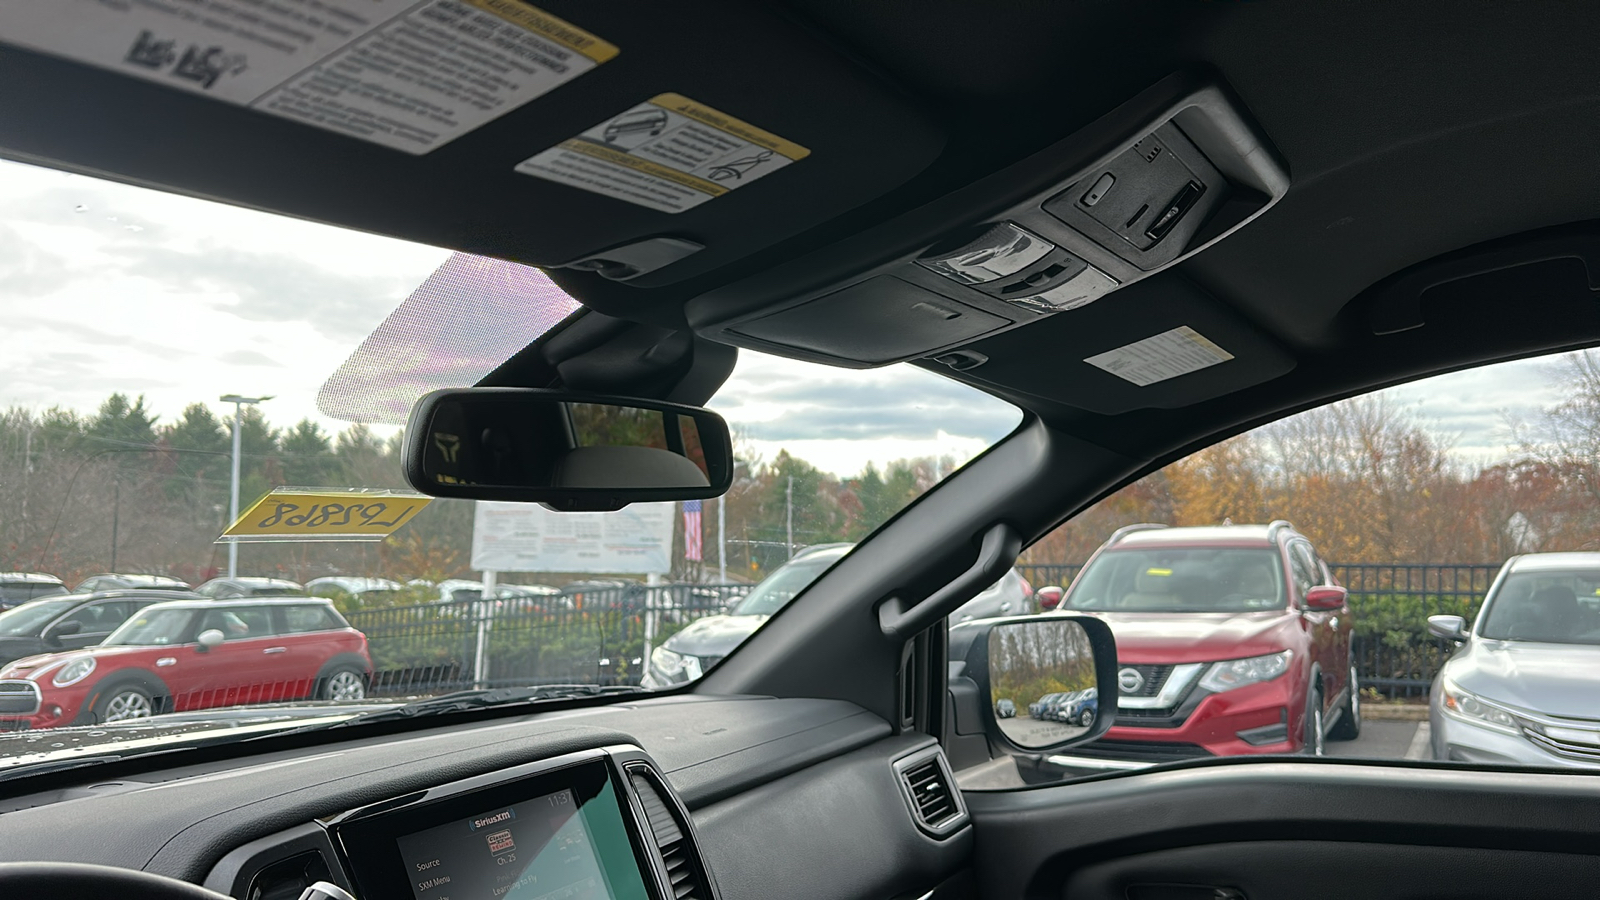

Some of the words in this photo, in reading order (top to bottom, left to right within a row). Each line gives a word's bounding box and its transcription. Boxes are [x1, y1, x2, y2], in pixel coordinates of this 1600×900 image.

[549, 791, 572, 807] 11:37
[416, 858, 441, 872] Source
[497, 856, 508, 866] Ch.
[508, 853, 517, 863] 25
[418, 878, 434, 892] SXM
[432, 875, 451, 887] Menu
[492, 879, 521, 896] Learning
[527, 874, 538, 885] Fly
